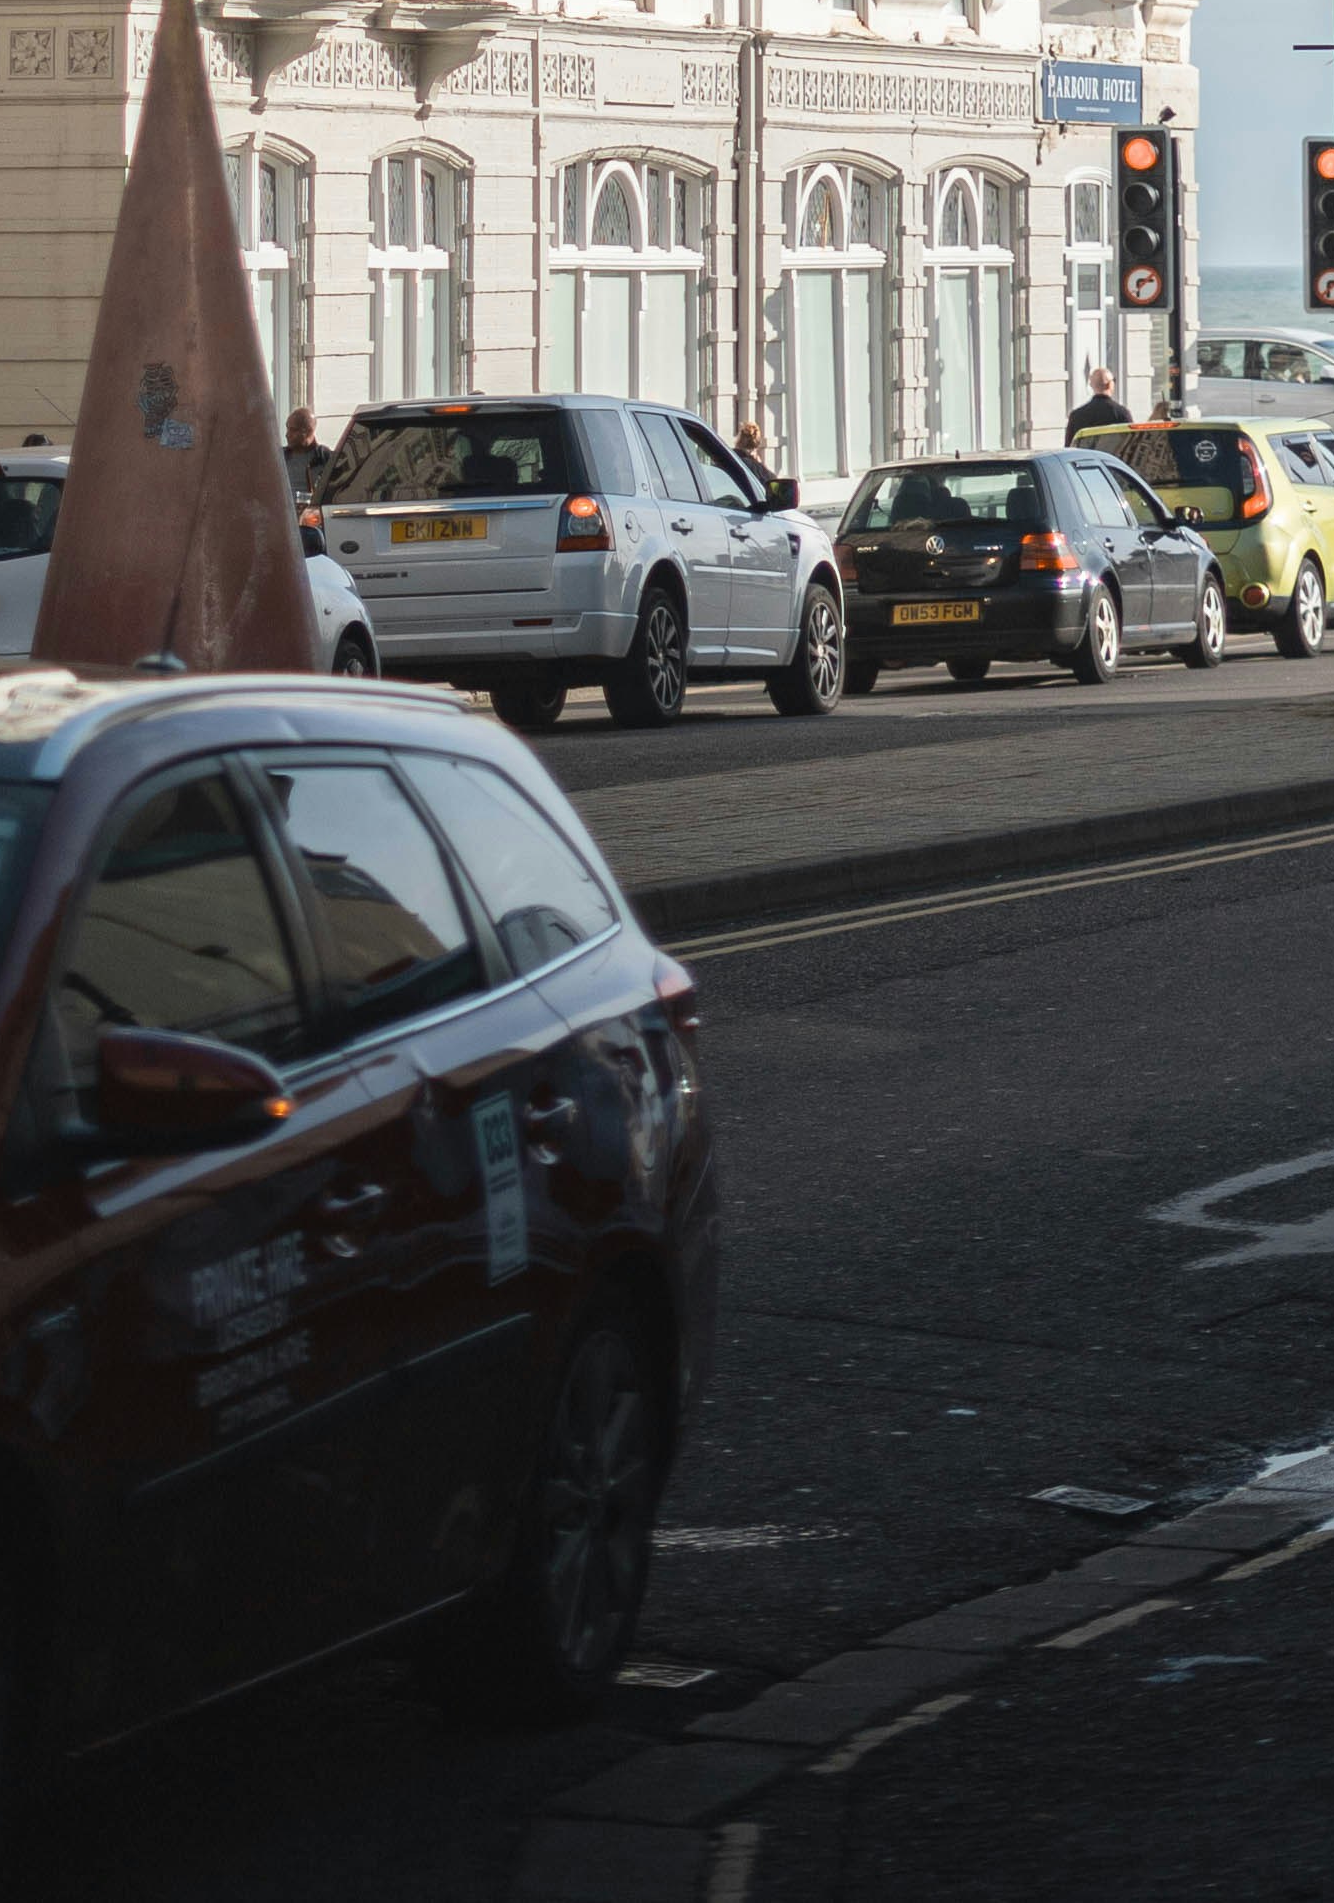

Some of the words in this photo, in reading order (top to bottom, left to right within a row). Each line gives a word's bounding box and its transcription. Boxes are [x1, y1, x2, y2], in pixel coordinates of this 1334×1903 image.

[1048, 75, 1100, 101] HARBOUR
[1102, 78, 1138, 103] HOTEL
[405, 522, 435, 539] GK11
[191, 1247, 265, 1328] PRIVATE
[266, 1230, 308, 1289] HIRE
